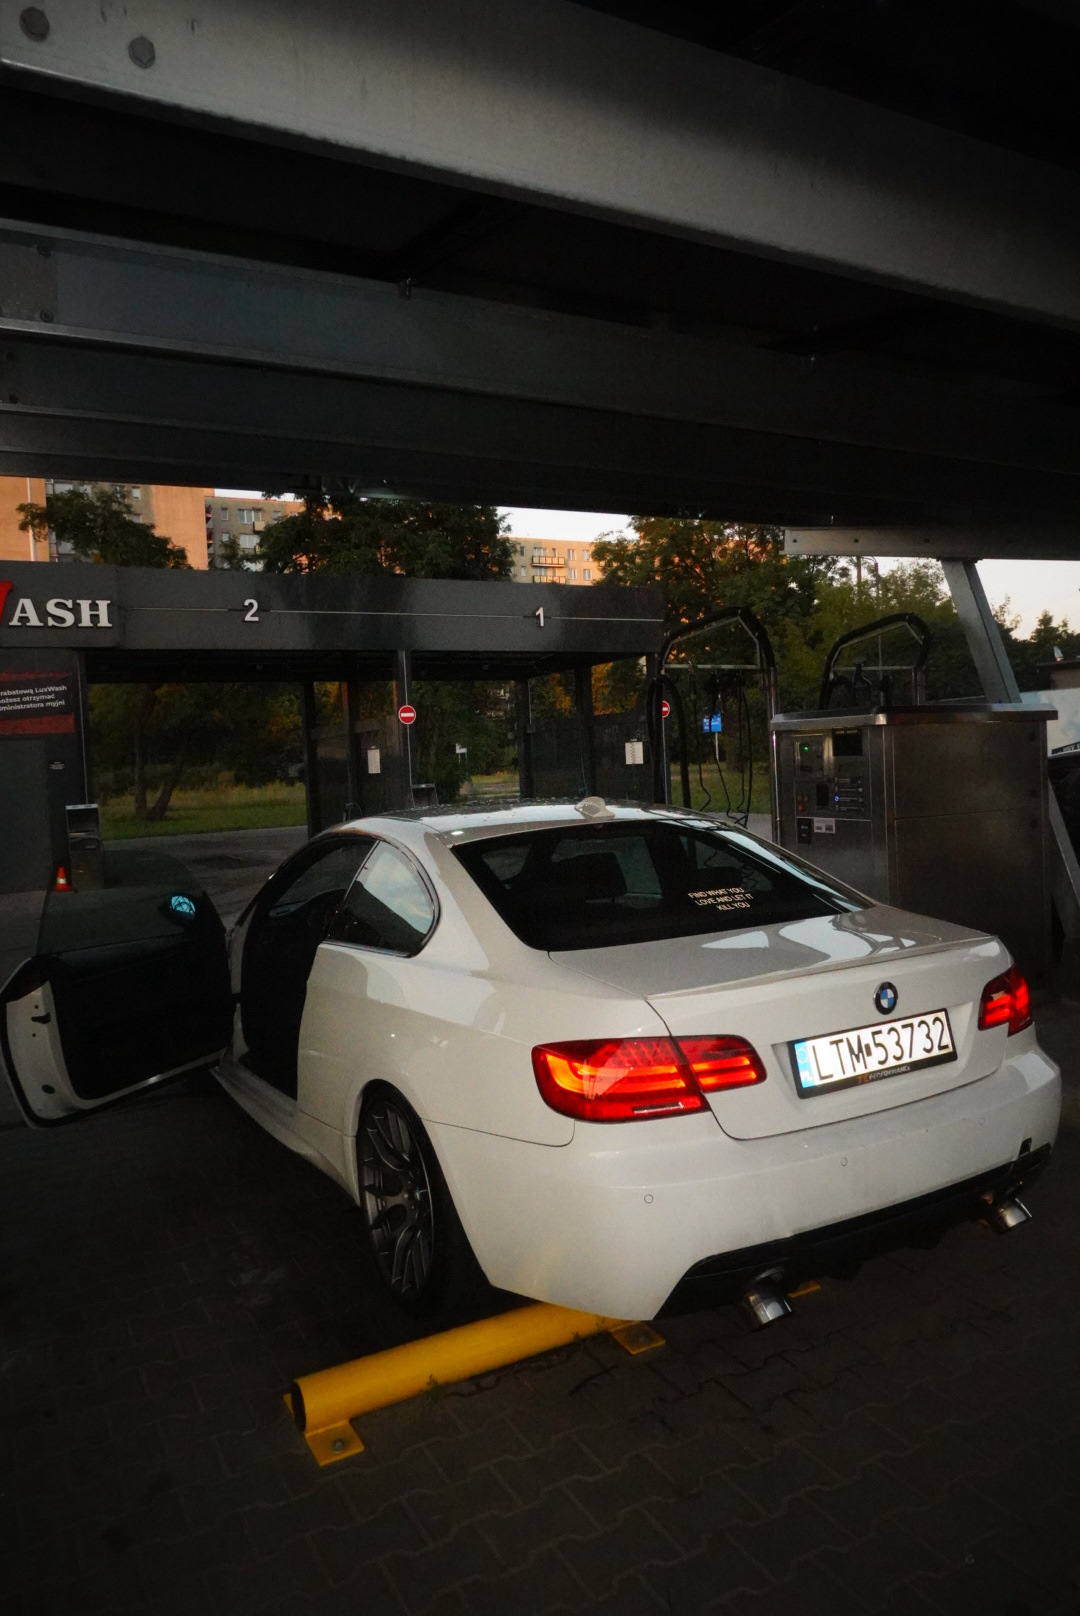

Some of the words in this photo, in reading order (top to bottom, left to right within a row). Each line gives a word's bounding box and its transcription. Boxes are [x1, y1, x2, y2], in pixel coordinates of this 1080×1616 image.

[243, 598, 259, 621] 2
[535, 606, 545, 627] 1
[0, 688, 34, 696] rabatową
[35, 685, 67, 693] LuxWash
[22, 693, 55, 702] otrzymać
[0, 702, 44, 711] ministratora
[46, 700, 65, 708] myjni
[811, 1034, 868, 1081] LTM
[870, 1016, 950, 1066] 53732
